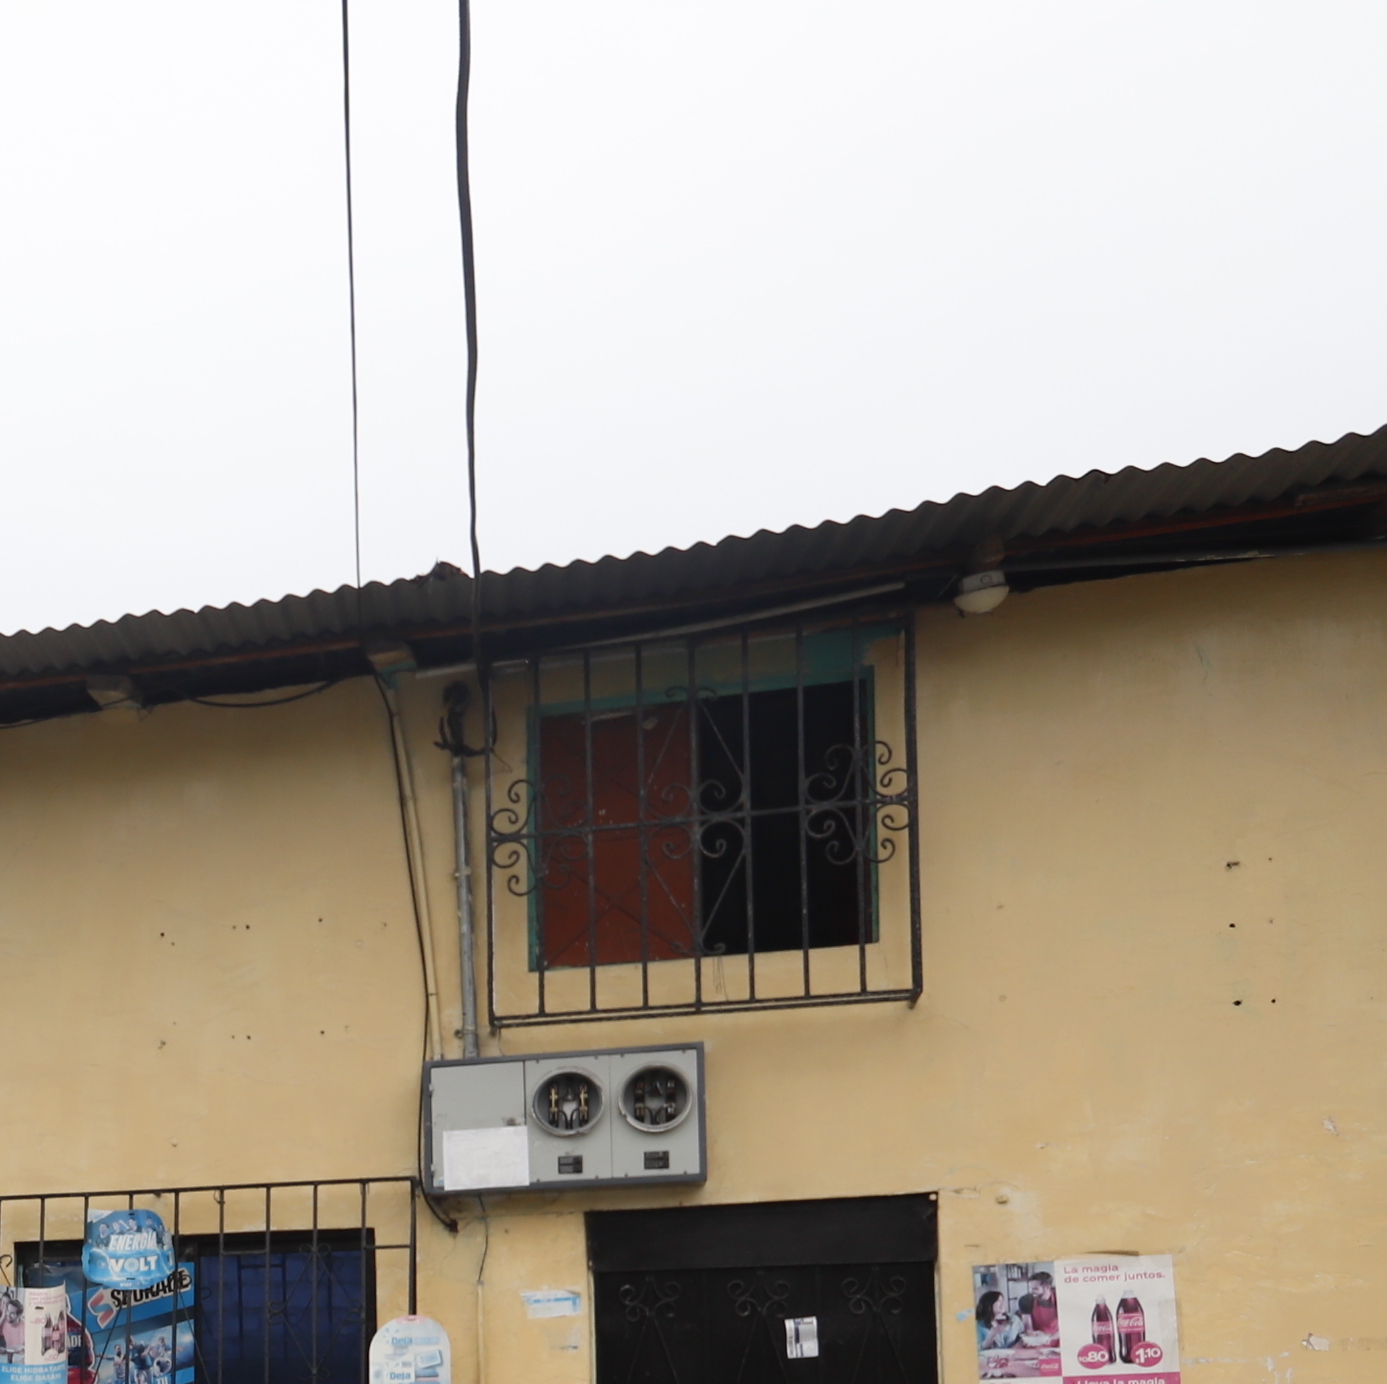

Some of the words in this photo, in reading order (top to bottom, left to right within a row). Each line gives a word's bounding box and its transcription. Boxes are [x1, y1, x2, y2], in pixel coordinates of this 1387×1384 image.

[109, 1255, 158, 1273] VOLT
[1063, 1266, 1078, 1274] La
[1082, 1264, 1119, 1275] magia
[1064, 1275, 1079, 1283] de
[1082, 1274, 1120, 1283] comer
